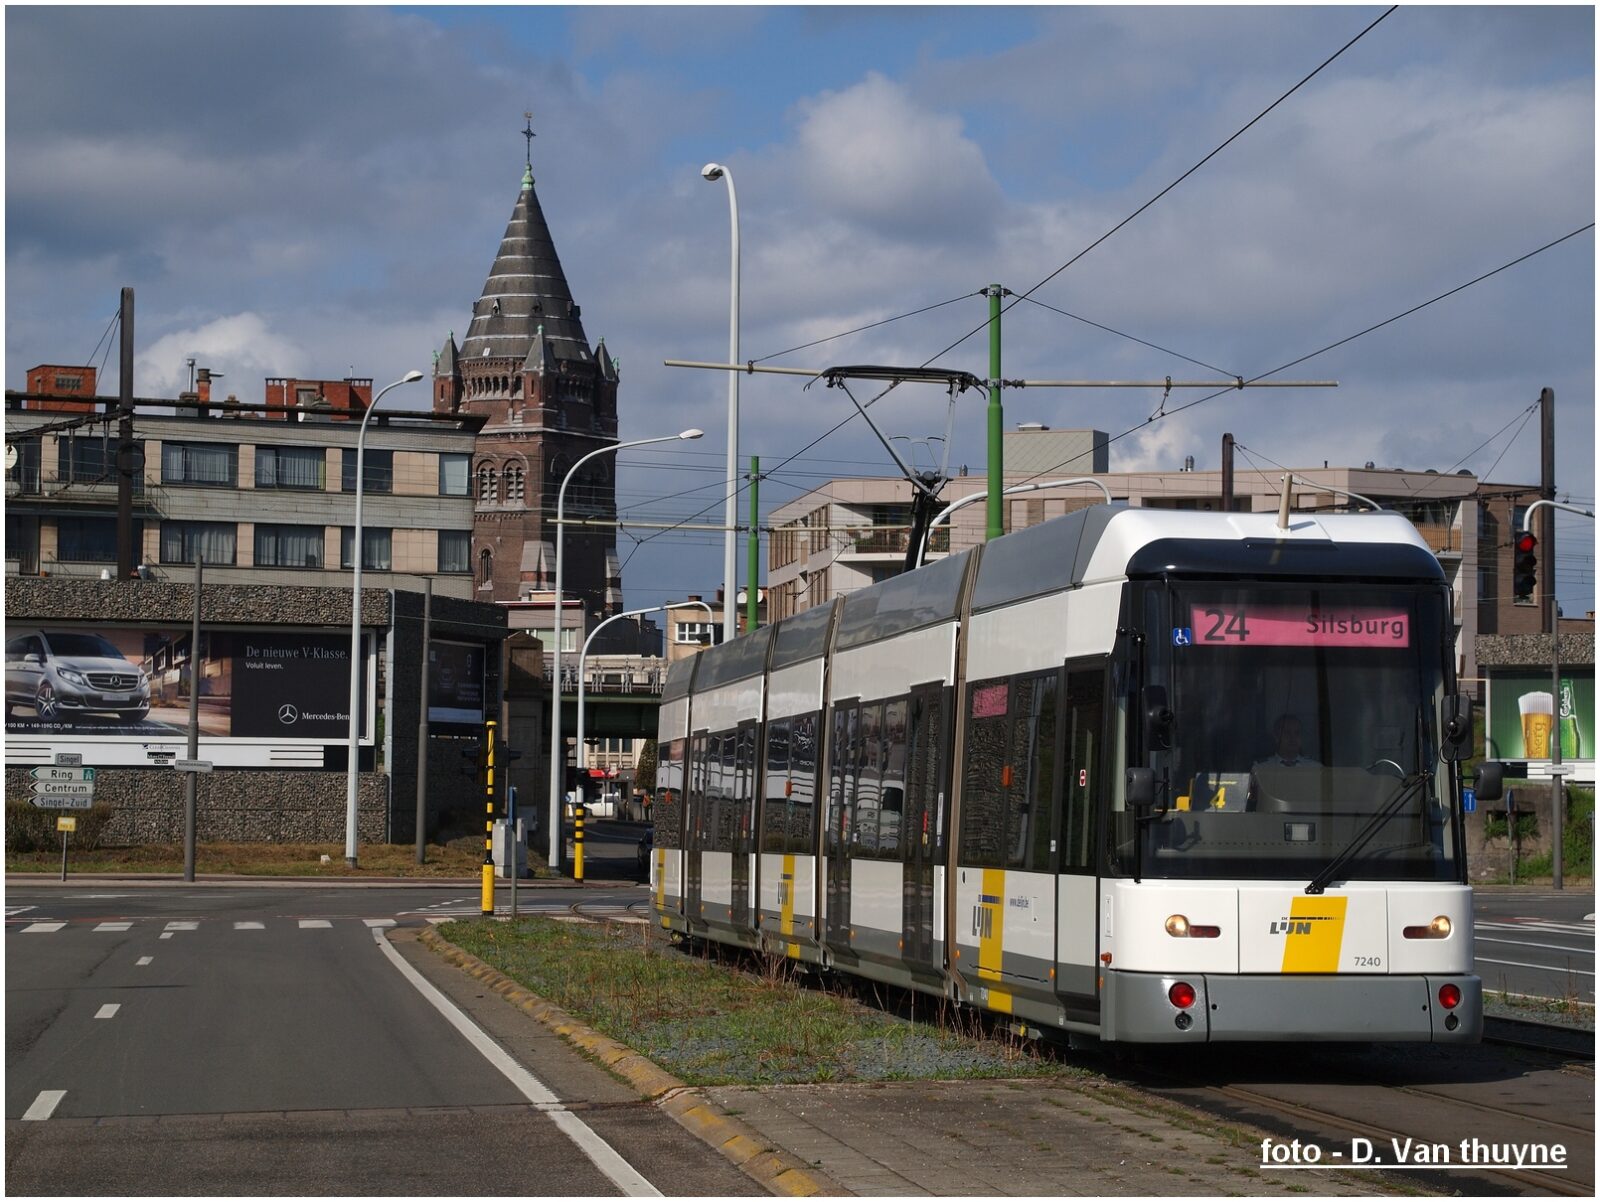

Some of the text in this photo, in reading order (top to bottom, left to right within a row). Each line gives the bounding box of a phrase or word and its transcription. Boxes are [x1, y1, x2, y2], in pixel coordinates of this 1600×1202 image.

[1204, 609, 1404, 642] 24 Silsburg
[246, 645, 348, 659] De nieuwe V-Klasse.
[245, 662, 284, 670] Voluit leven.
[301, 712, 350, 721] Mercedes-Ben
[59, 755, 80, 765] Singel
[51, 769, 73, 780] Ring
[44, 783, 88, 793] Centrum
[40, 797, 88, 808] Singel-Zuid
[1354, 956, 1381, 967] 7240
